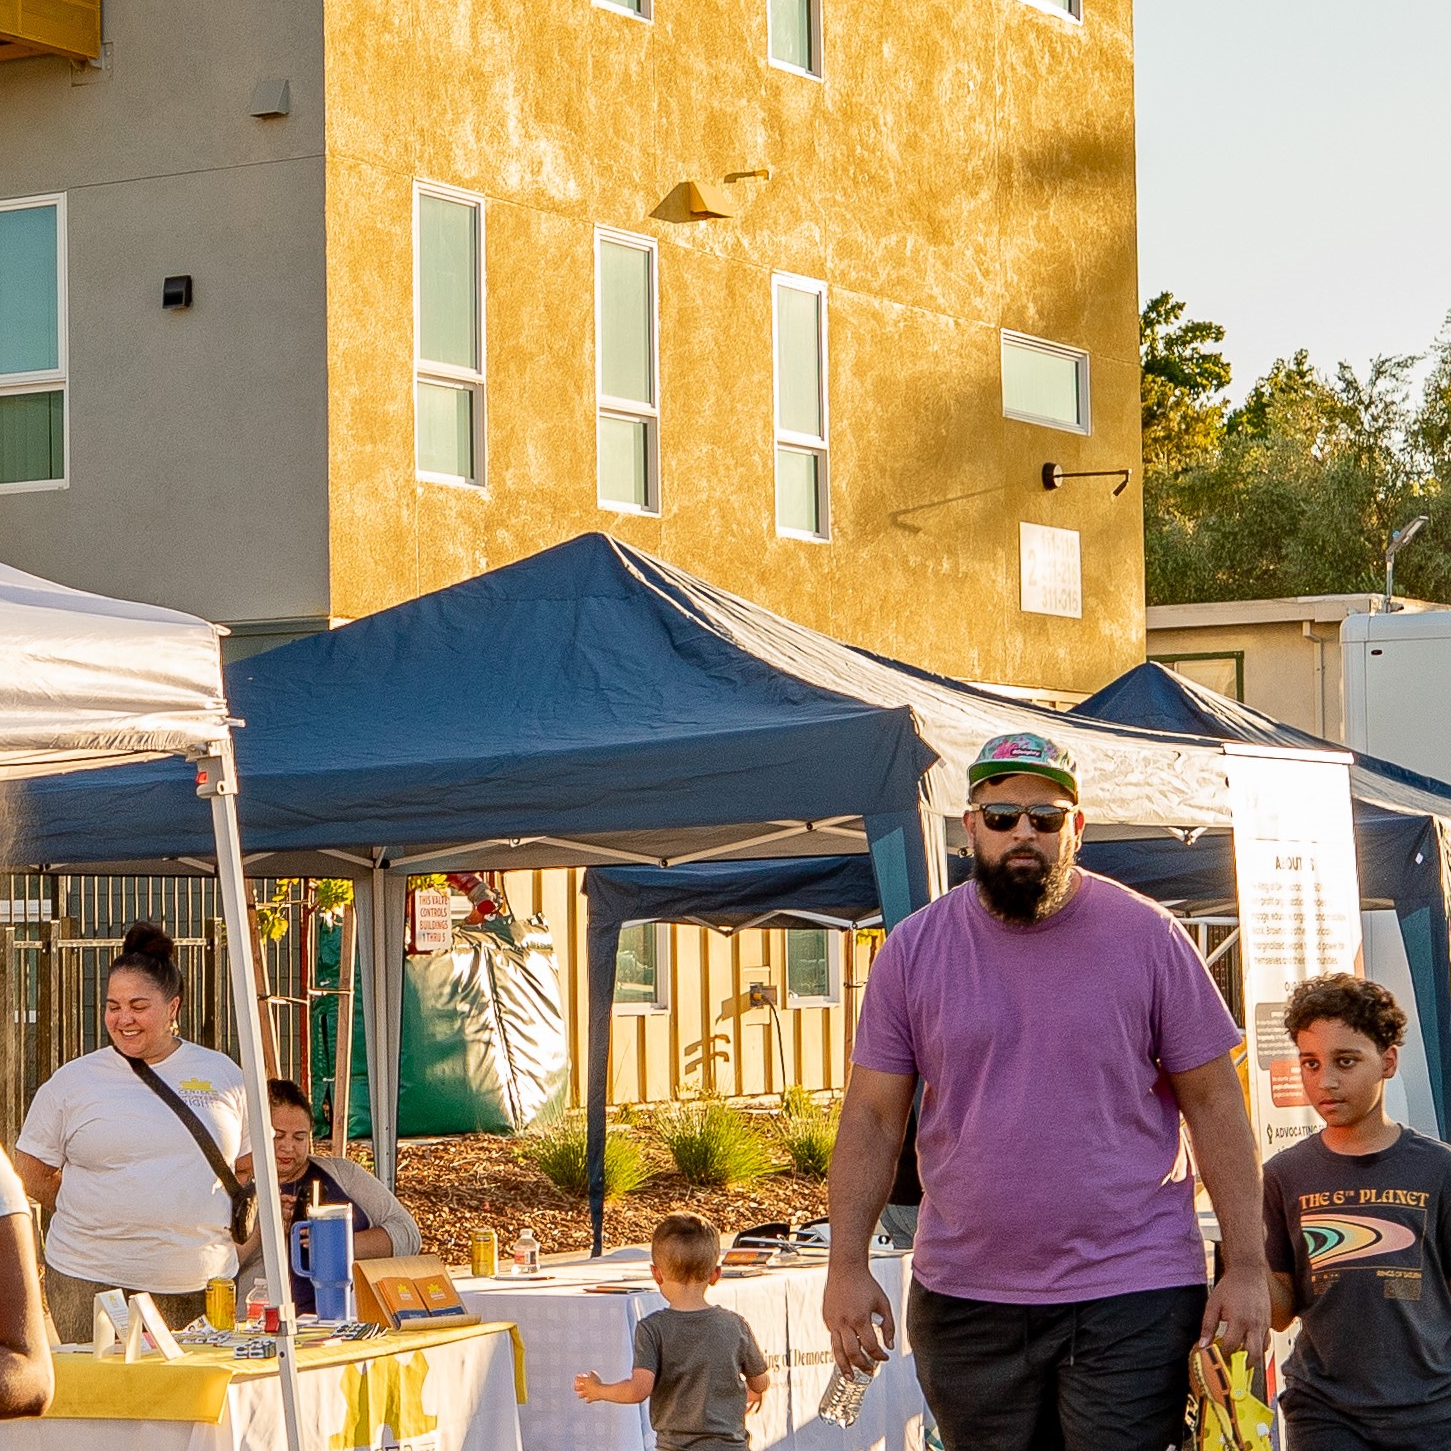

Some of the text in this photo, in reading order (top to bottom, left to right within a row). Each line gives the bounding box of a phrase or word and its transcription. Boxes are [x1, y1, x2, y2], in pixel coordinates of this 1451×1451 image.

[420, 907, 448, 917] CONTROLS
[419, 920, 449, 931] BUILDINGS
[1299, 1192, 1330, 1209] THE
[1359, 1189, 1429, 1207] PLANET
[764, 1349, 780, 1373] ing
[794, 1349, 834, 1367] Democra
